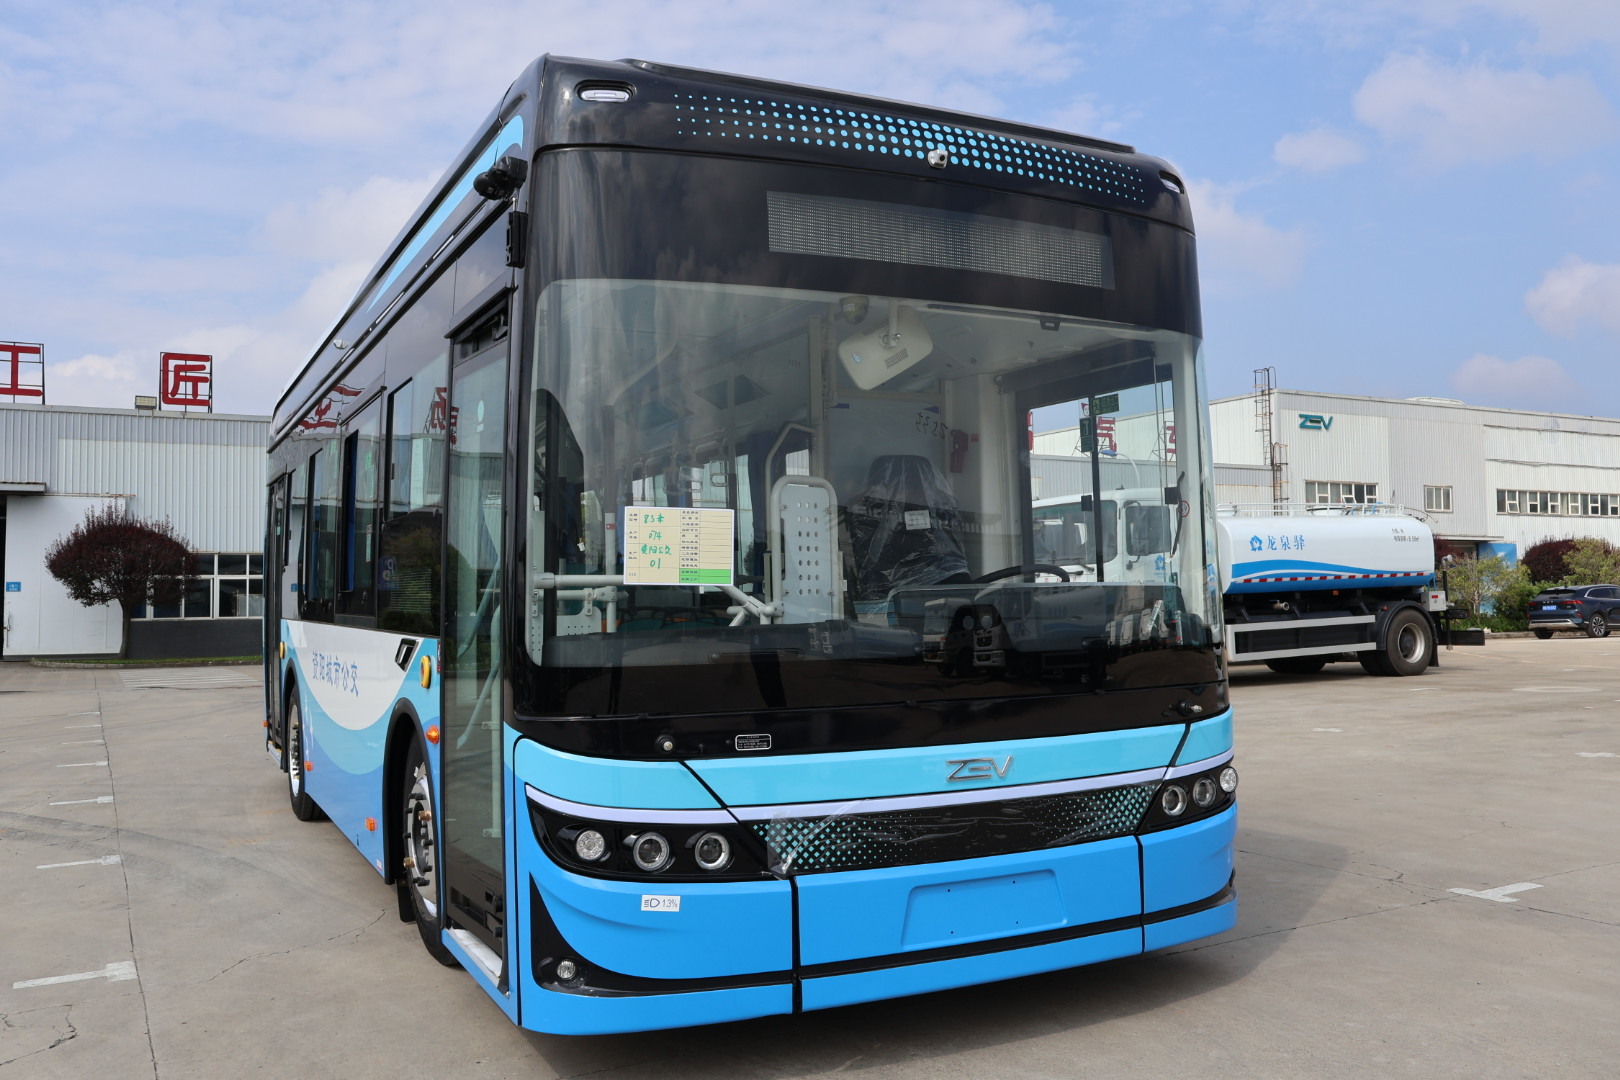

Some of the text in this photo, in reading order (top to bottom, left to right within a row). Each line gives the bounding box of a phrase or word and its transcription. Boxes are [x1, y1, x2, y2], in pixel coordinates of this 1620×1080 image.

[1299, 414, 1333, 430] ZEV
[1267, 535, 1305, 551] 龙泉驿
[946, 756, 1013, 782] ZEV
